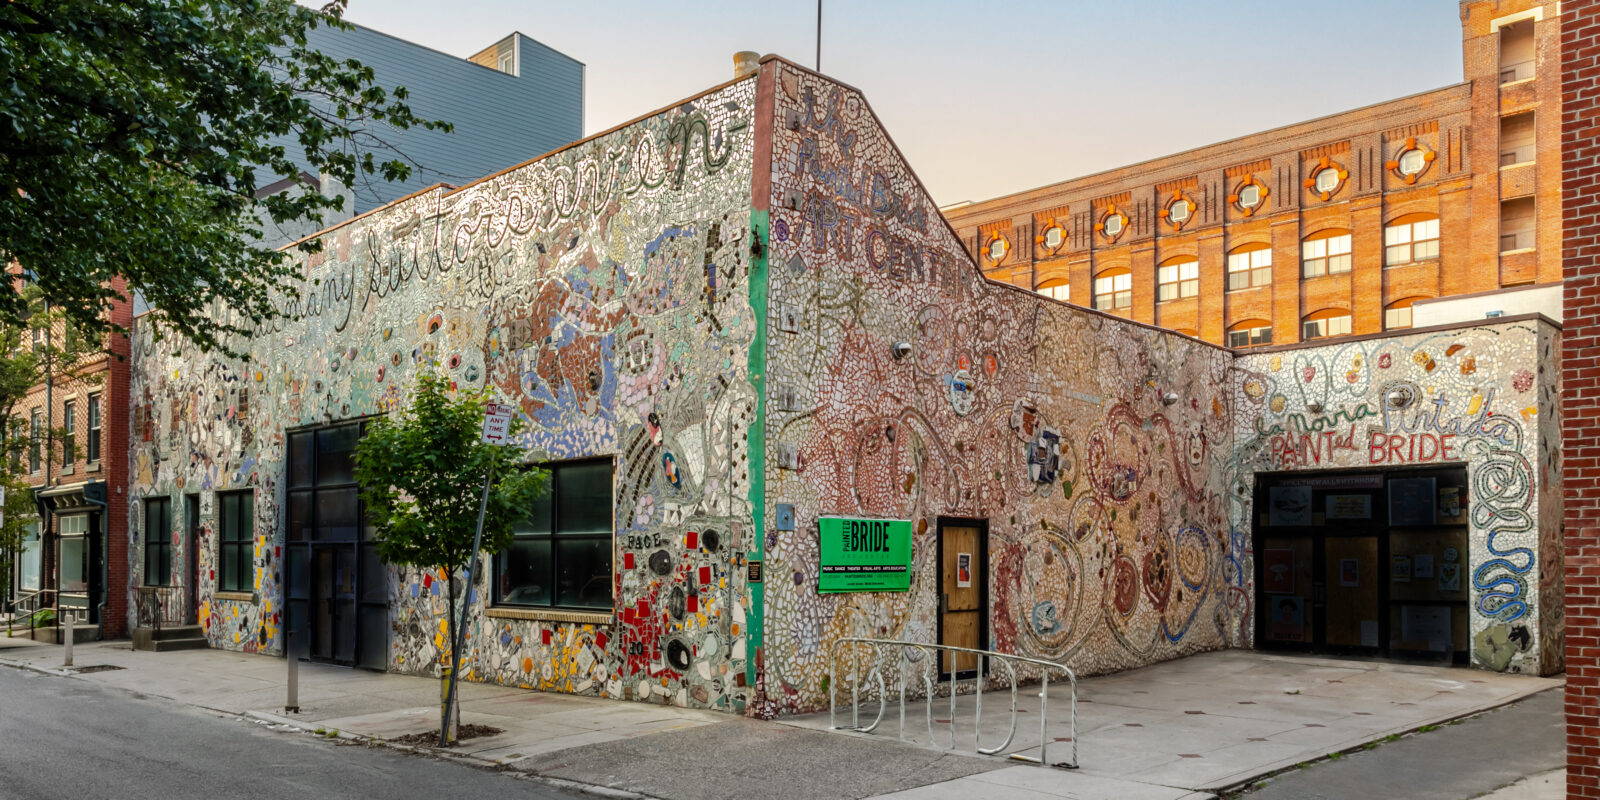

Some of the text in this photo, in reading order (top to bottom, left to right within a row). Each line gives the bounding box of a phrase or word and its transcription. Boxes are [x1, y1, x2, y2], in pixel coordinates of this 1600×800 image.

[796, 191, 858, 259] ART
[488, 425, 504, 433] TIME
[1368, 432, 1460, 464] BRIDE
[627, 532, 661, 550] FACE
[842, 520, 890, 552] PAINTED BRIDE
